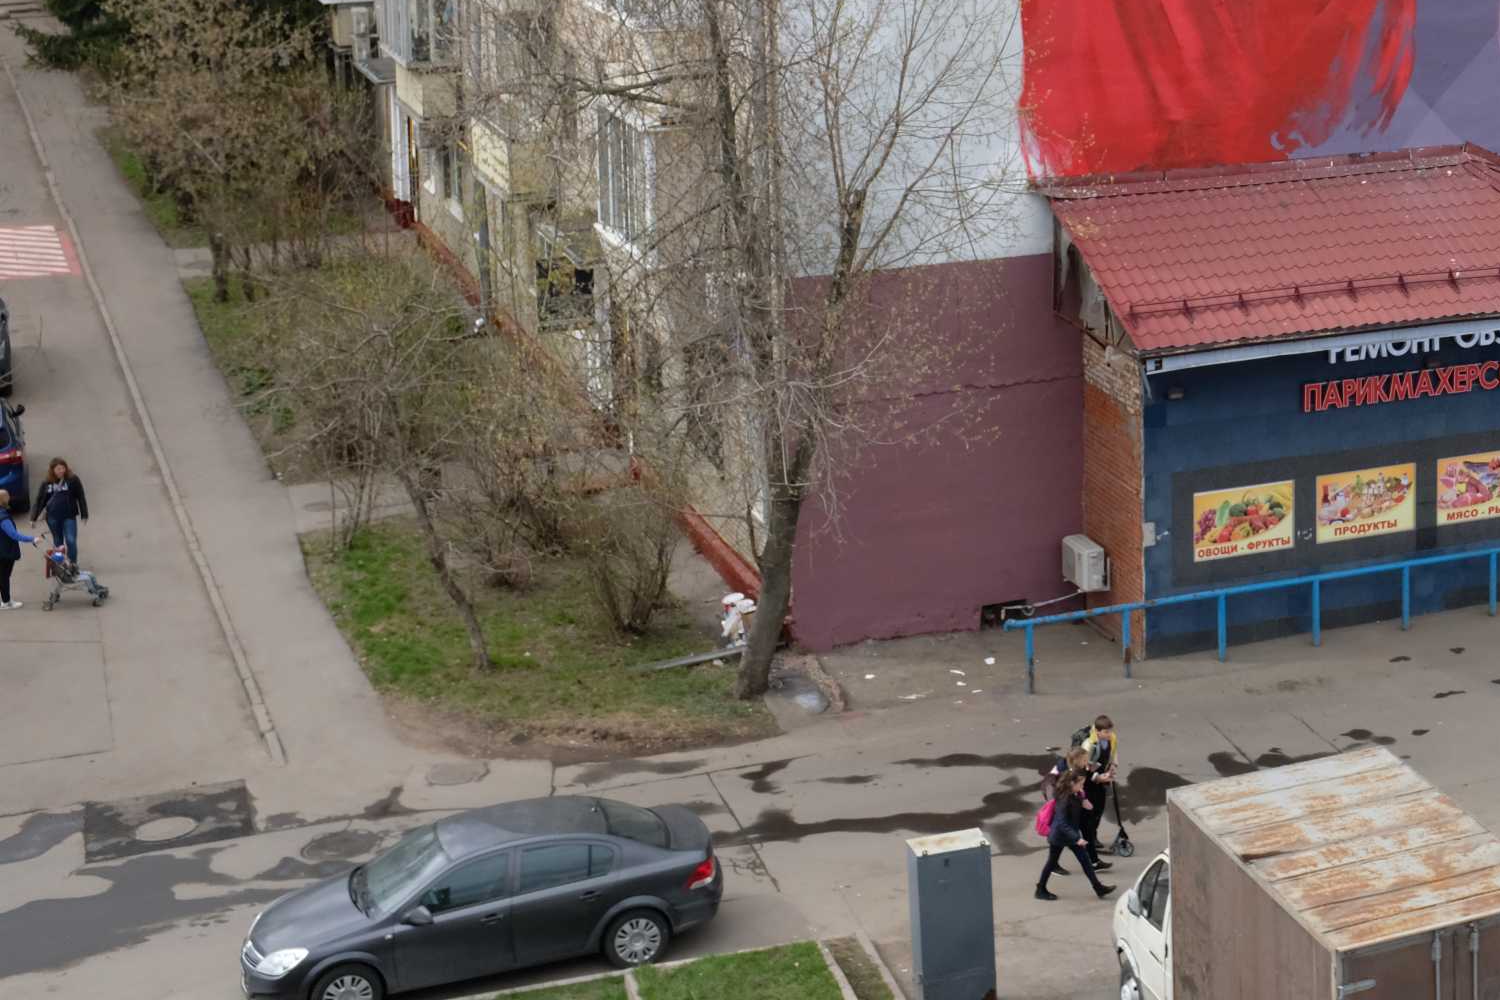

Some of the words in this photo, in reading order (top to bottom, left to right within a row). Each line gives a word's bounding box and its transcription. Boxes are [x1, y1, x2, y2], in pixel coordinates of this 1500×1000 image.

[1446, 507, 1479, 521] МЯСО
[1334, 519, 1398, 537] ПРОДУКТЫ
[1197, 543, 1239, 559] ОВОЩИ
[1247, 535, 1291, 551] ФРУКТЫ
